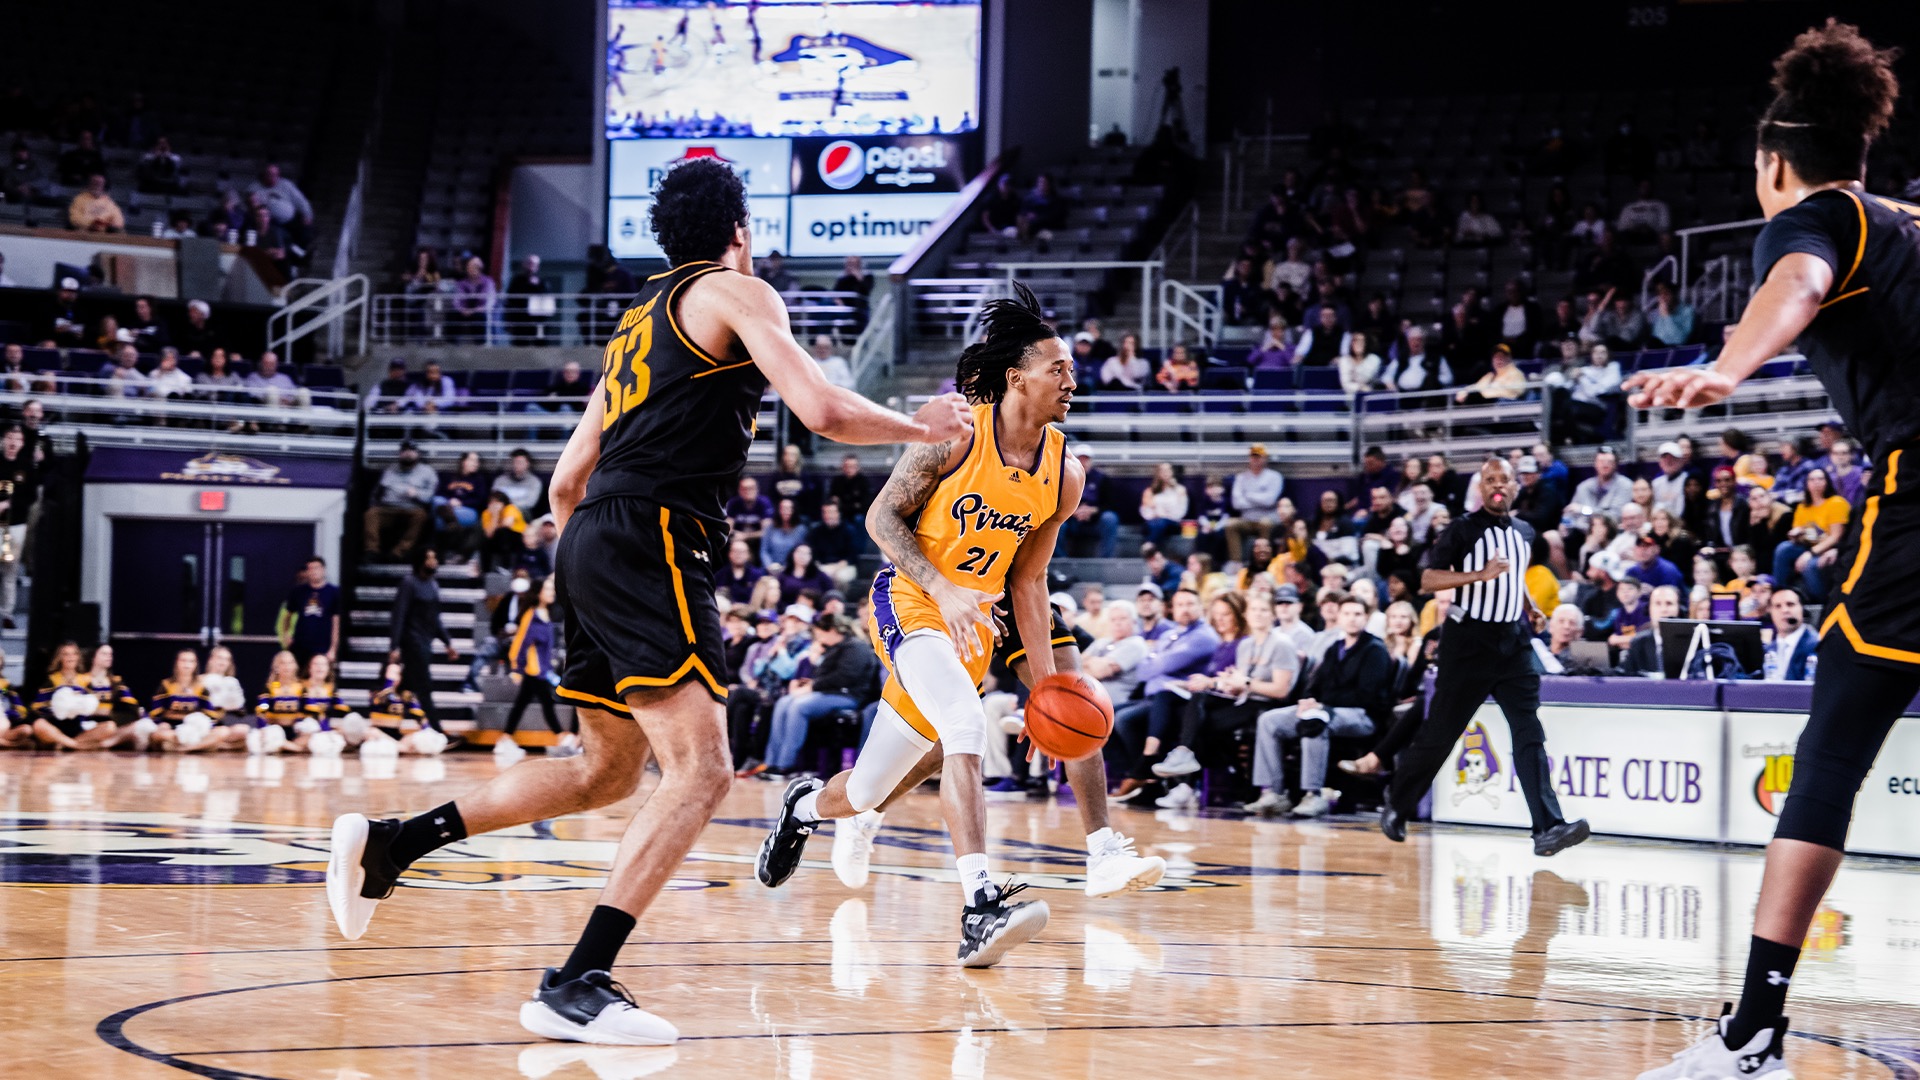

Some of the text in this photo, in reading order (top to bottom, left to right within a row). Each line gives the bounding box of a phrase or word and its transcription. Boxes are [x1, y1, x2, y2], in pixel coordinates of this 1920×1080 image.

[866, 142, 947, 175] pepsi
[603, 315, 653, 431] 33
[956, 546, 1000, 577] 21
[1622, 758, 1702, 804] CLUB
